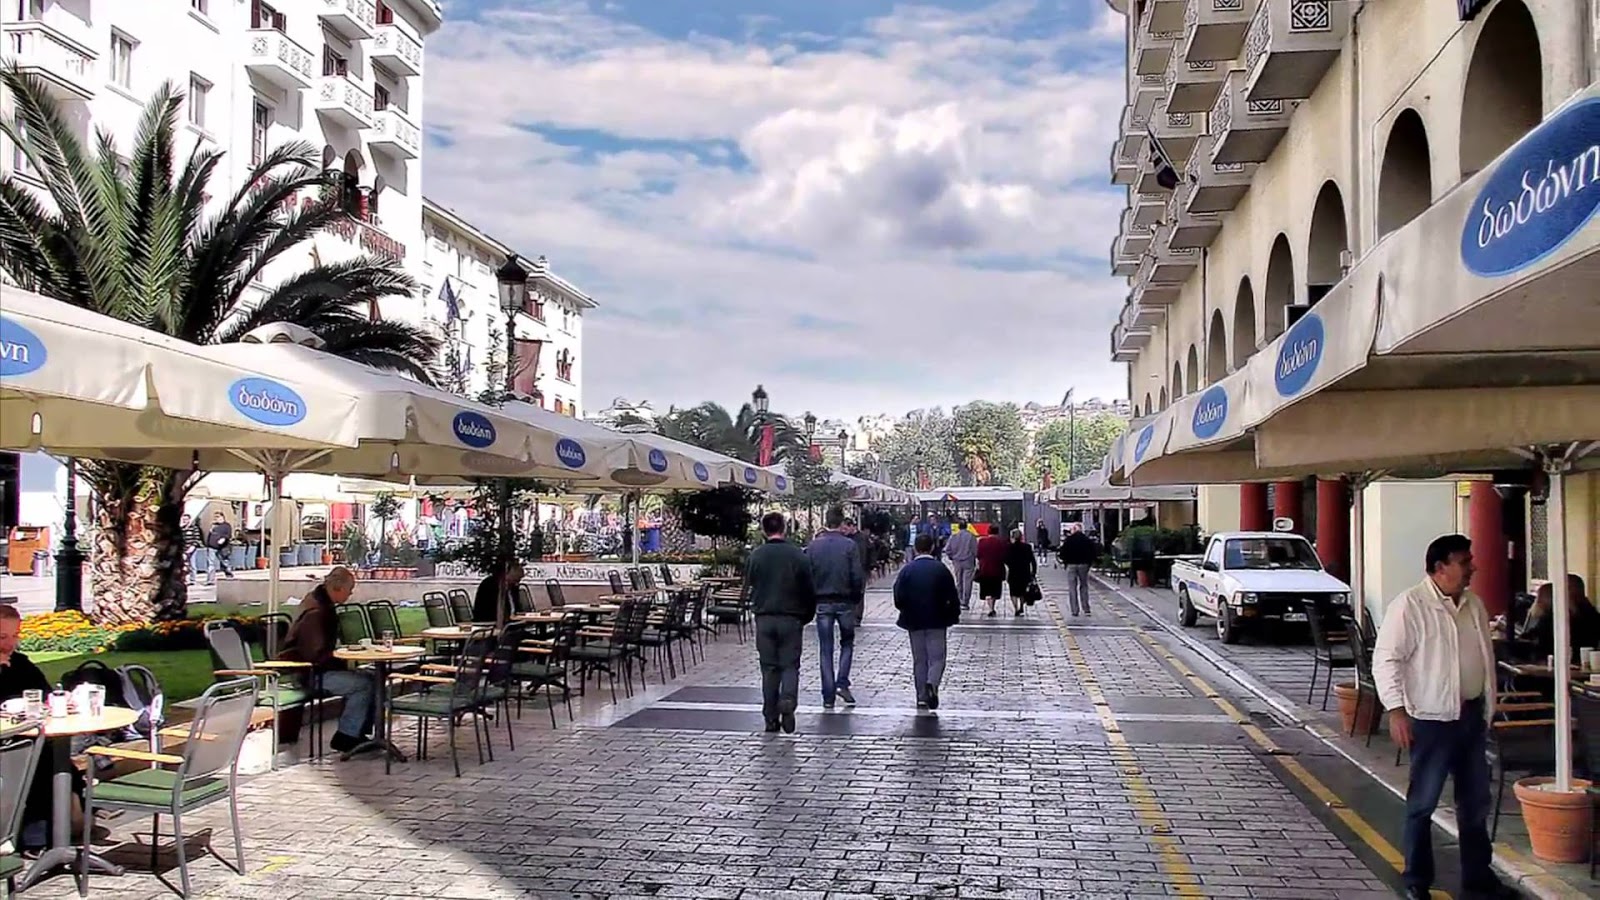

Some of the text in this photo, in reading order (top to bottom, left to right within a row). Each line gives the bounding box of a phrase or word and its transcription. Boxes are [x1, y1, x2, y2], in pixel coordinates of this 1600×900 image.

[1478, 145, 1600, 249] δωδώνη
[1280, 339, 1317, 379] δωδώνη
[239, 385, 298, 416] δωδώνη
